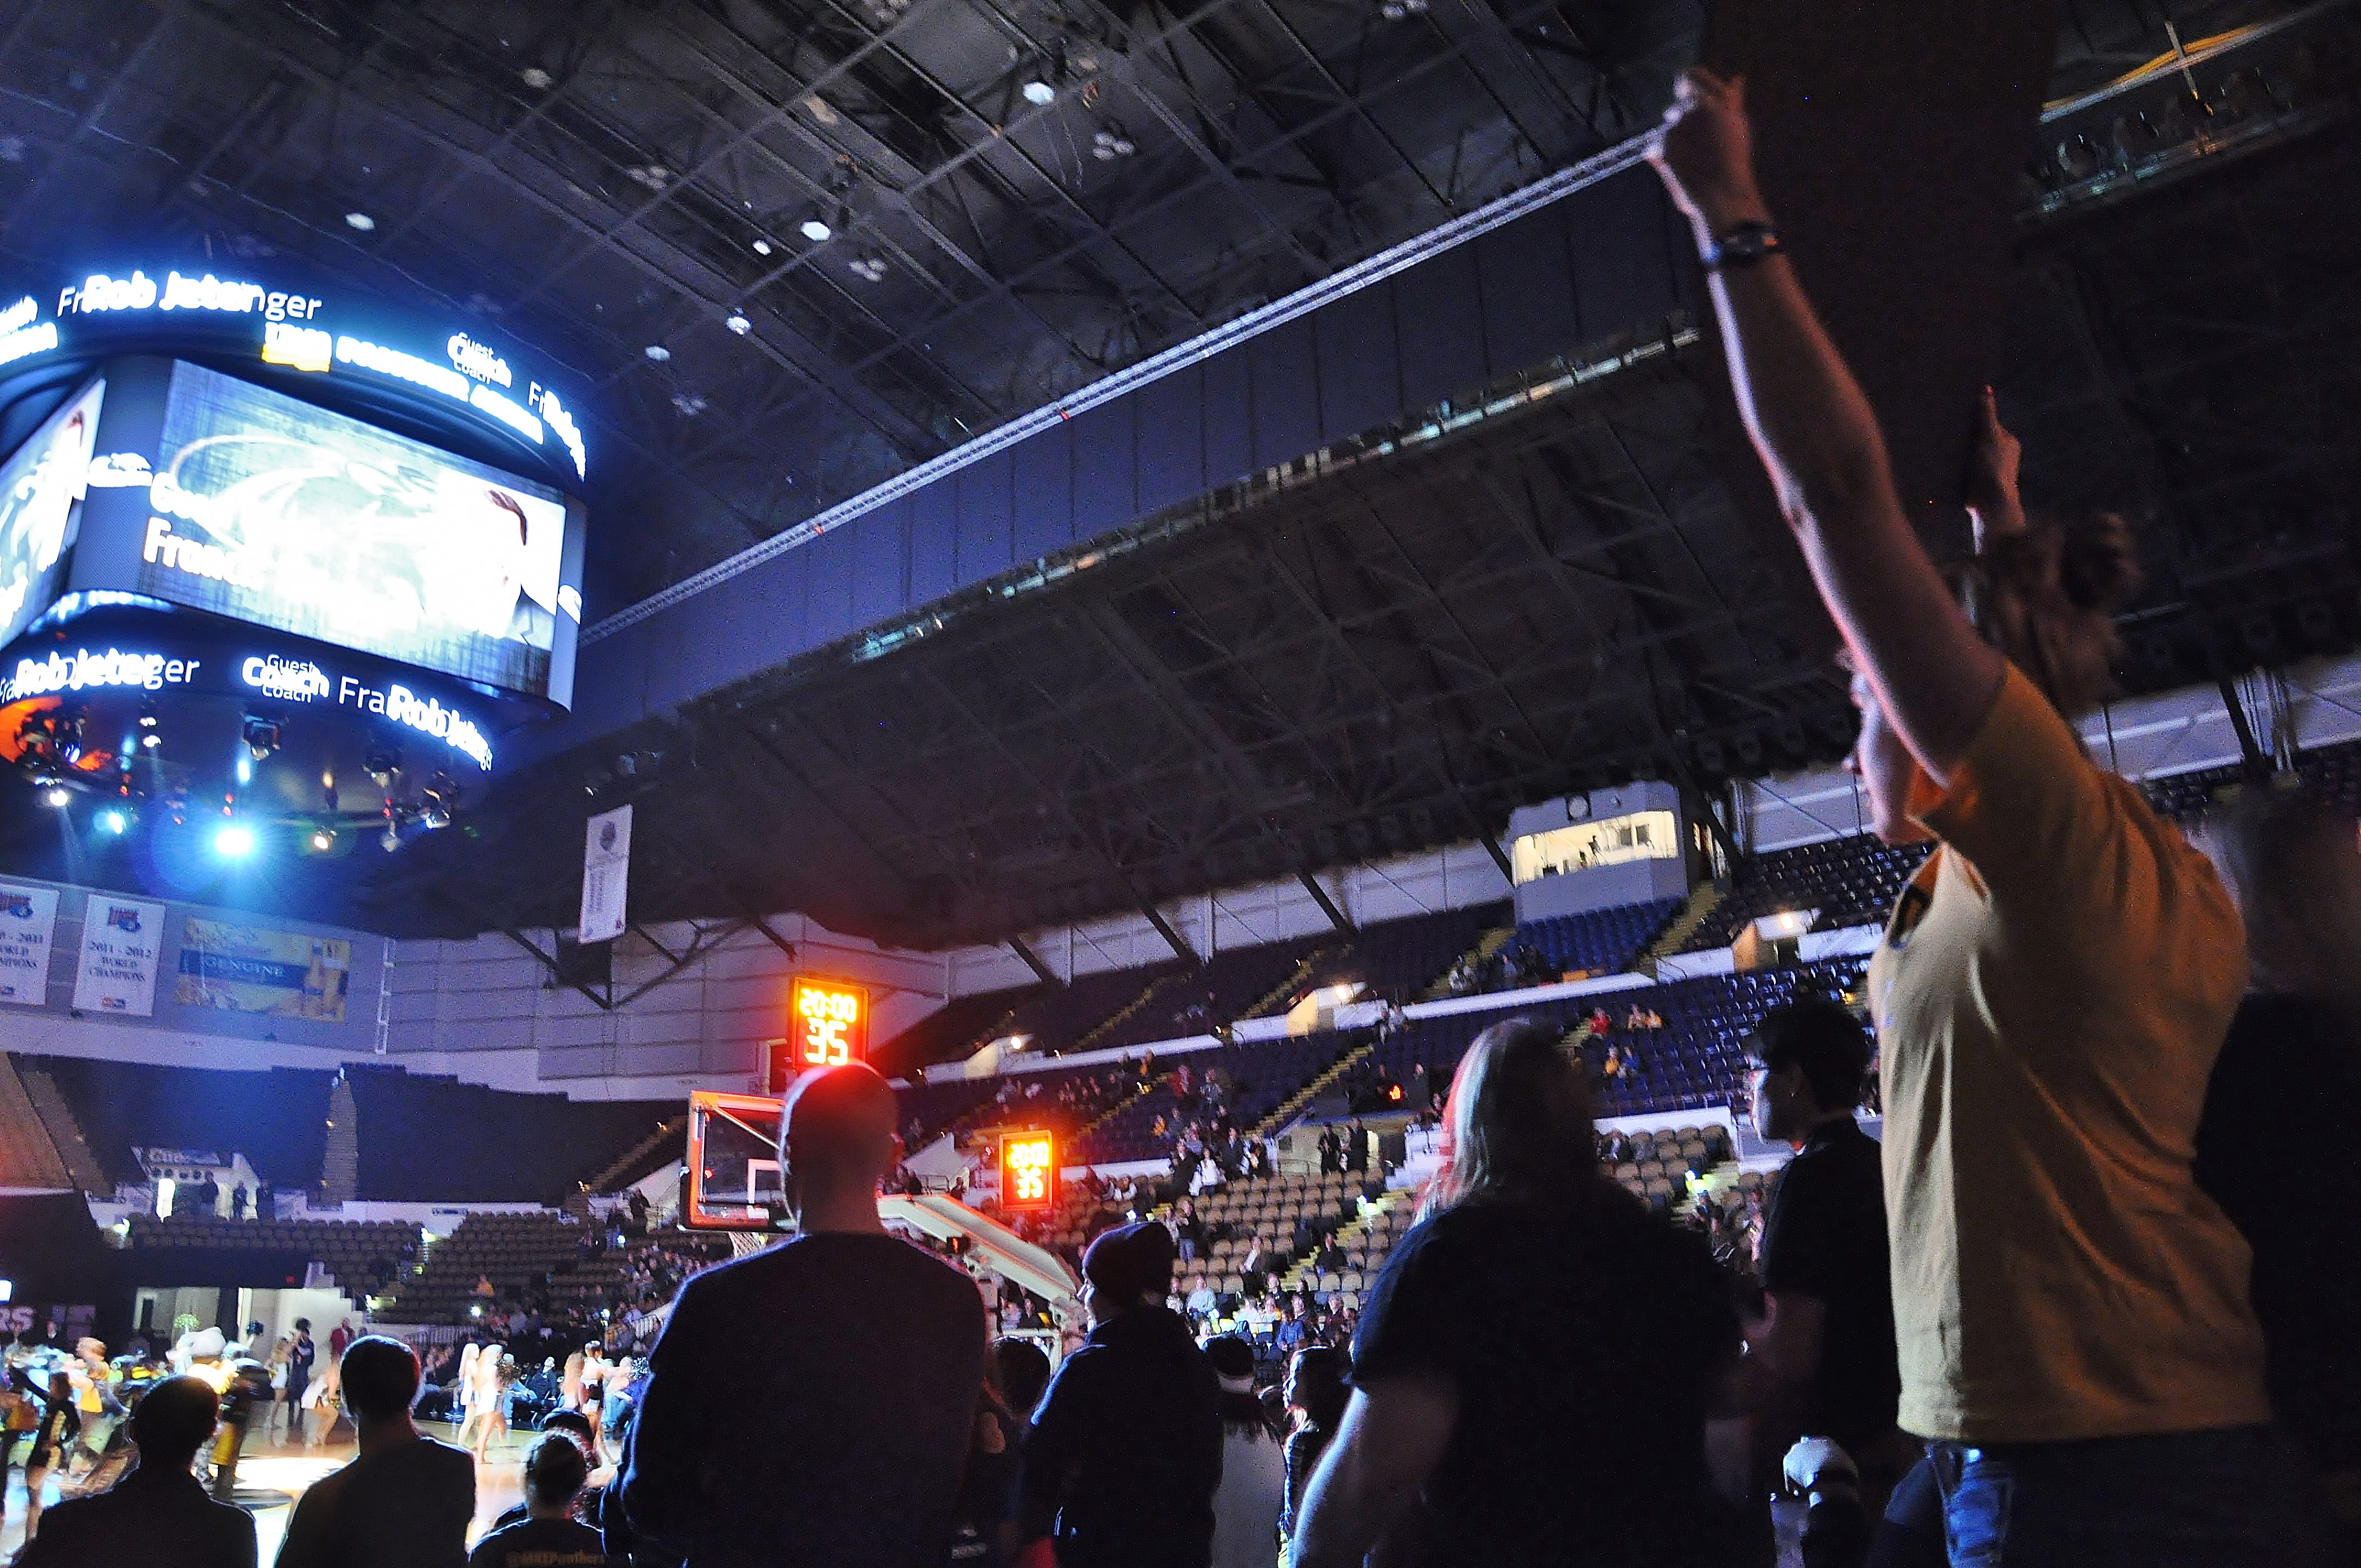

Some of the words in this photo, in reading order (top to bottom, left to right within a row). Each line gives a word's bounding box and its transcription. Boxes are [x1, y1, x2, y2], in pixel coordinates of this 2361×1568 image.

[204, 954, 285, 977] GENUINE
[799, 988, 857, 1023] 20:00
[804, 1017, 848, 1066] 35
[1017, 1167, 1044, 1199] 35
